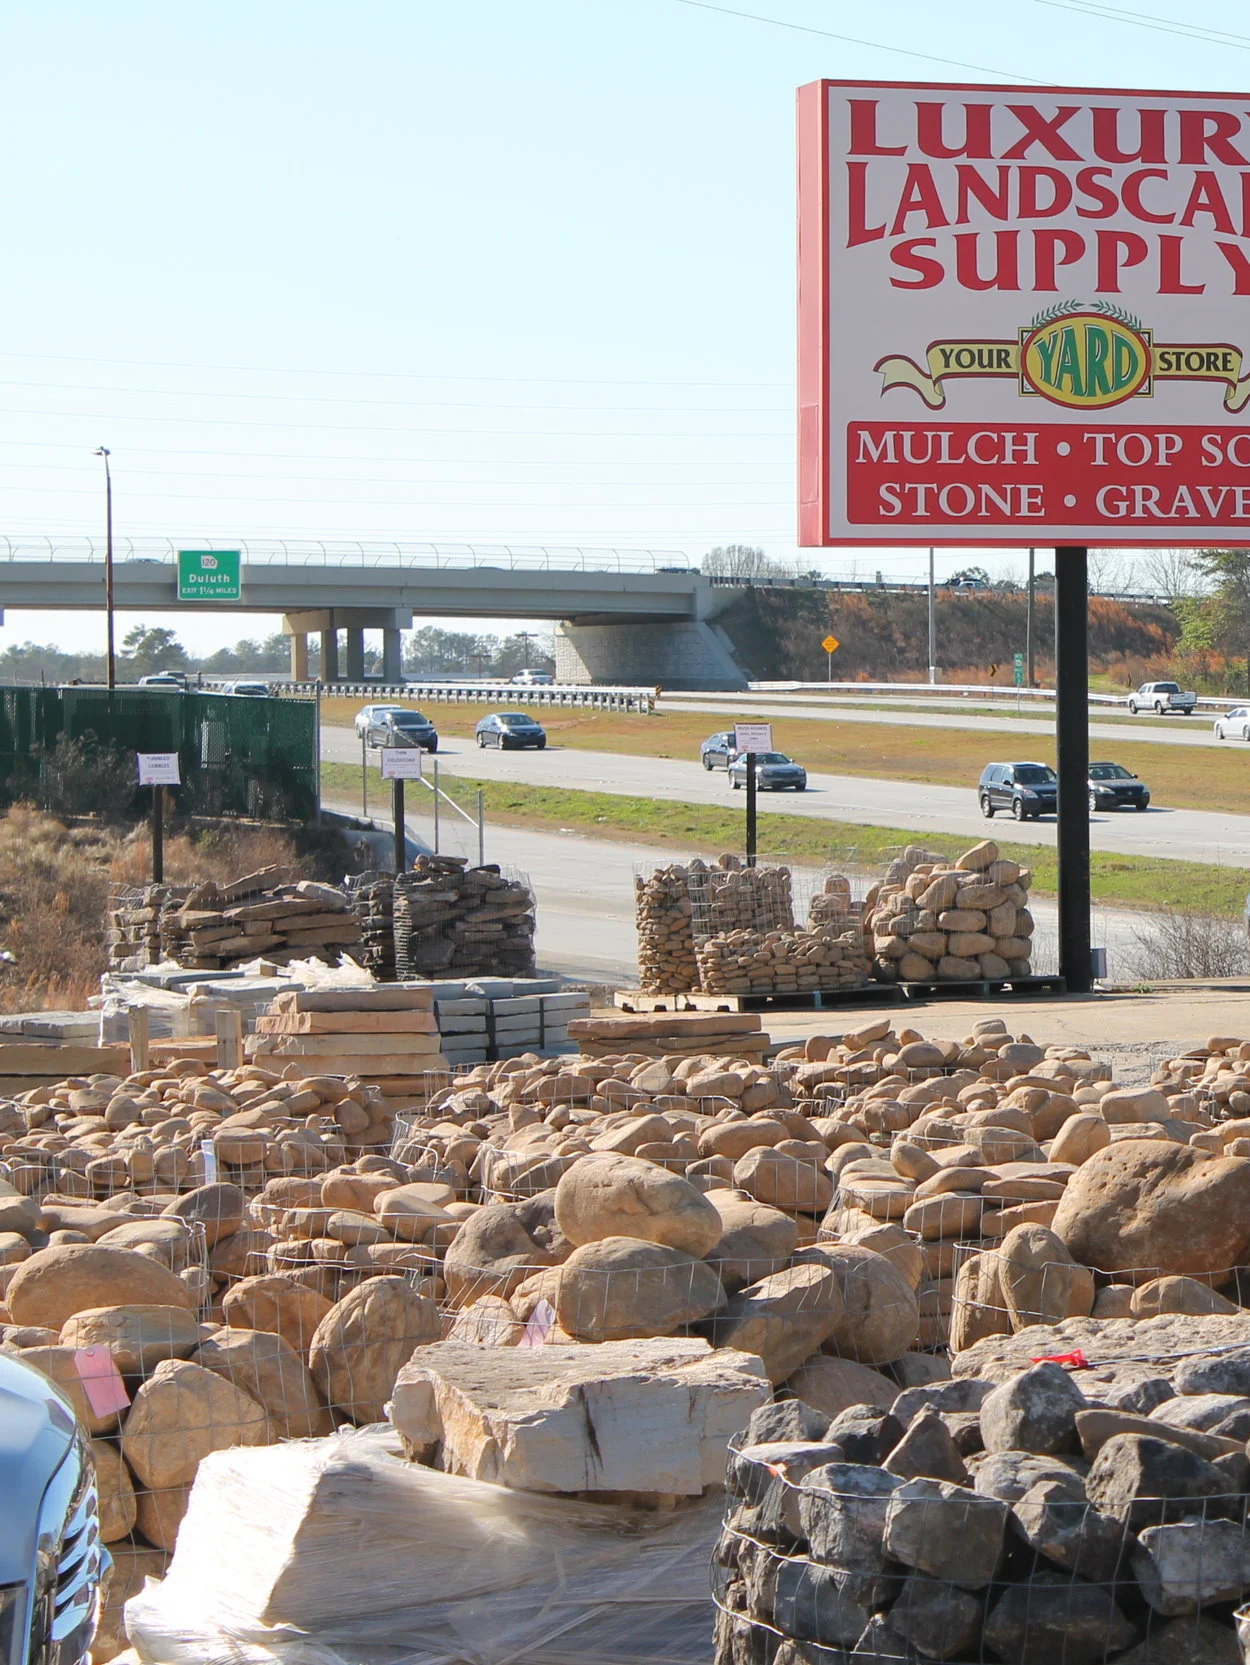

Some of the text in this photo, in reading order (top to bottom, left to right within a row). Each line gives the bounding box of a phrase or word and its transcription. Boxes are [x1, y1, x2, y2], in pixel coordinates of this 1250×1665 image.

[938, 323, 1235, 397] YOUR YARD STORE
[855, 430, 1040, 465] MULCH
[1083, 432, 1183, 467] TOP
[878, 482, 1045, 517] STONE
[189, 574, 230, 583] Duluth
[202, 558, 216, 567] 120
